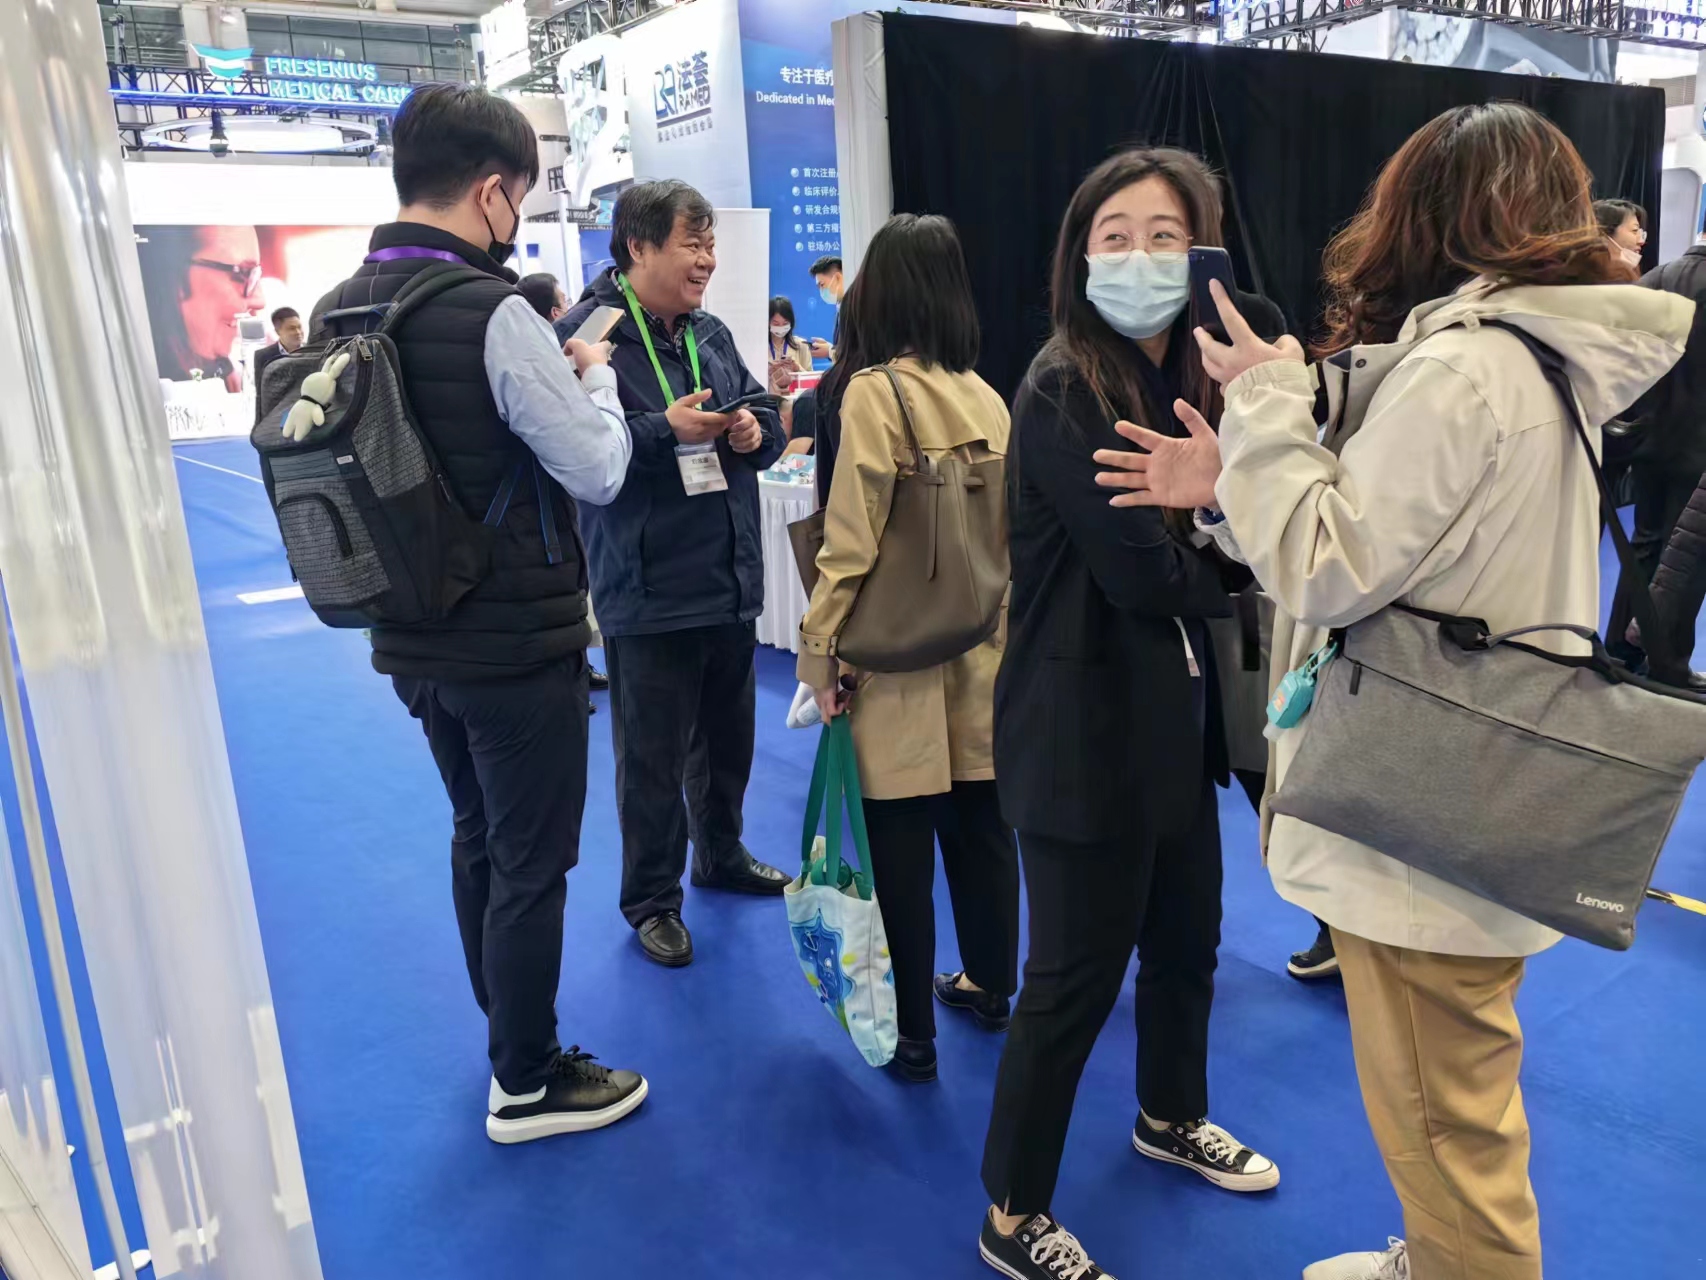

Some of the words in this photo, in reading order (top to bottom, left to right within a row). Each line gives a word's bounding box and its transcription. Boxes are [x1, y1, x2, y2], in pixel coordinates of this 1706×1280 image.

[265, 57, 378, 81] FRESENIUS
[268, 79, 359, 101] MEDICAL
[679, 85, 711, 111] RAMED
[756, 91, 804, 105] Dedicated
[806, 94, 815, 105] in
[803, 167, 838, 178] 首次注册
[804, 186, 839, 197] 临床评价
[805, 204, 840, 215] 研发合规
[1576, 892, 1625, 913] Lenovo
